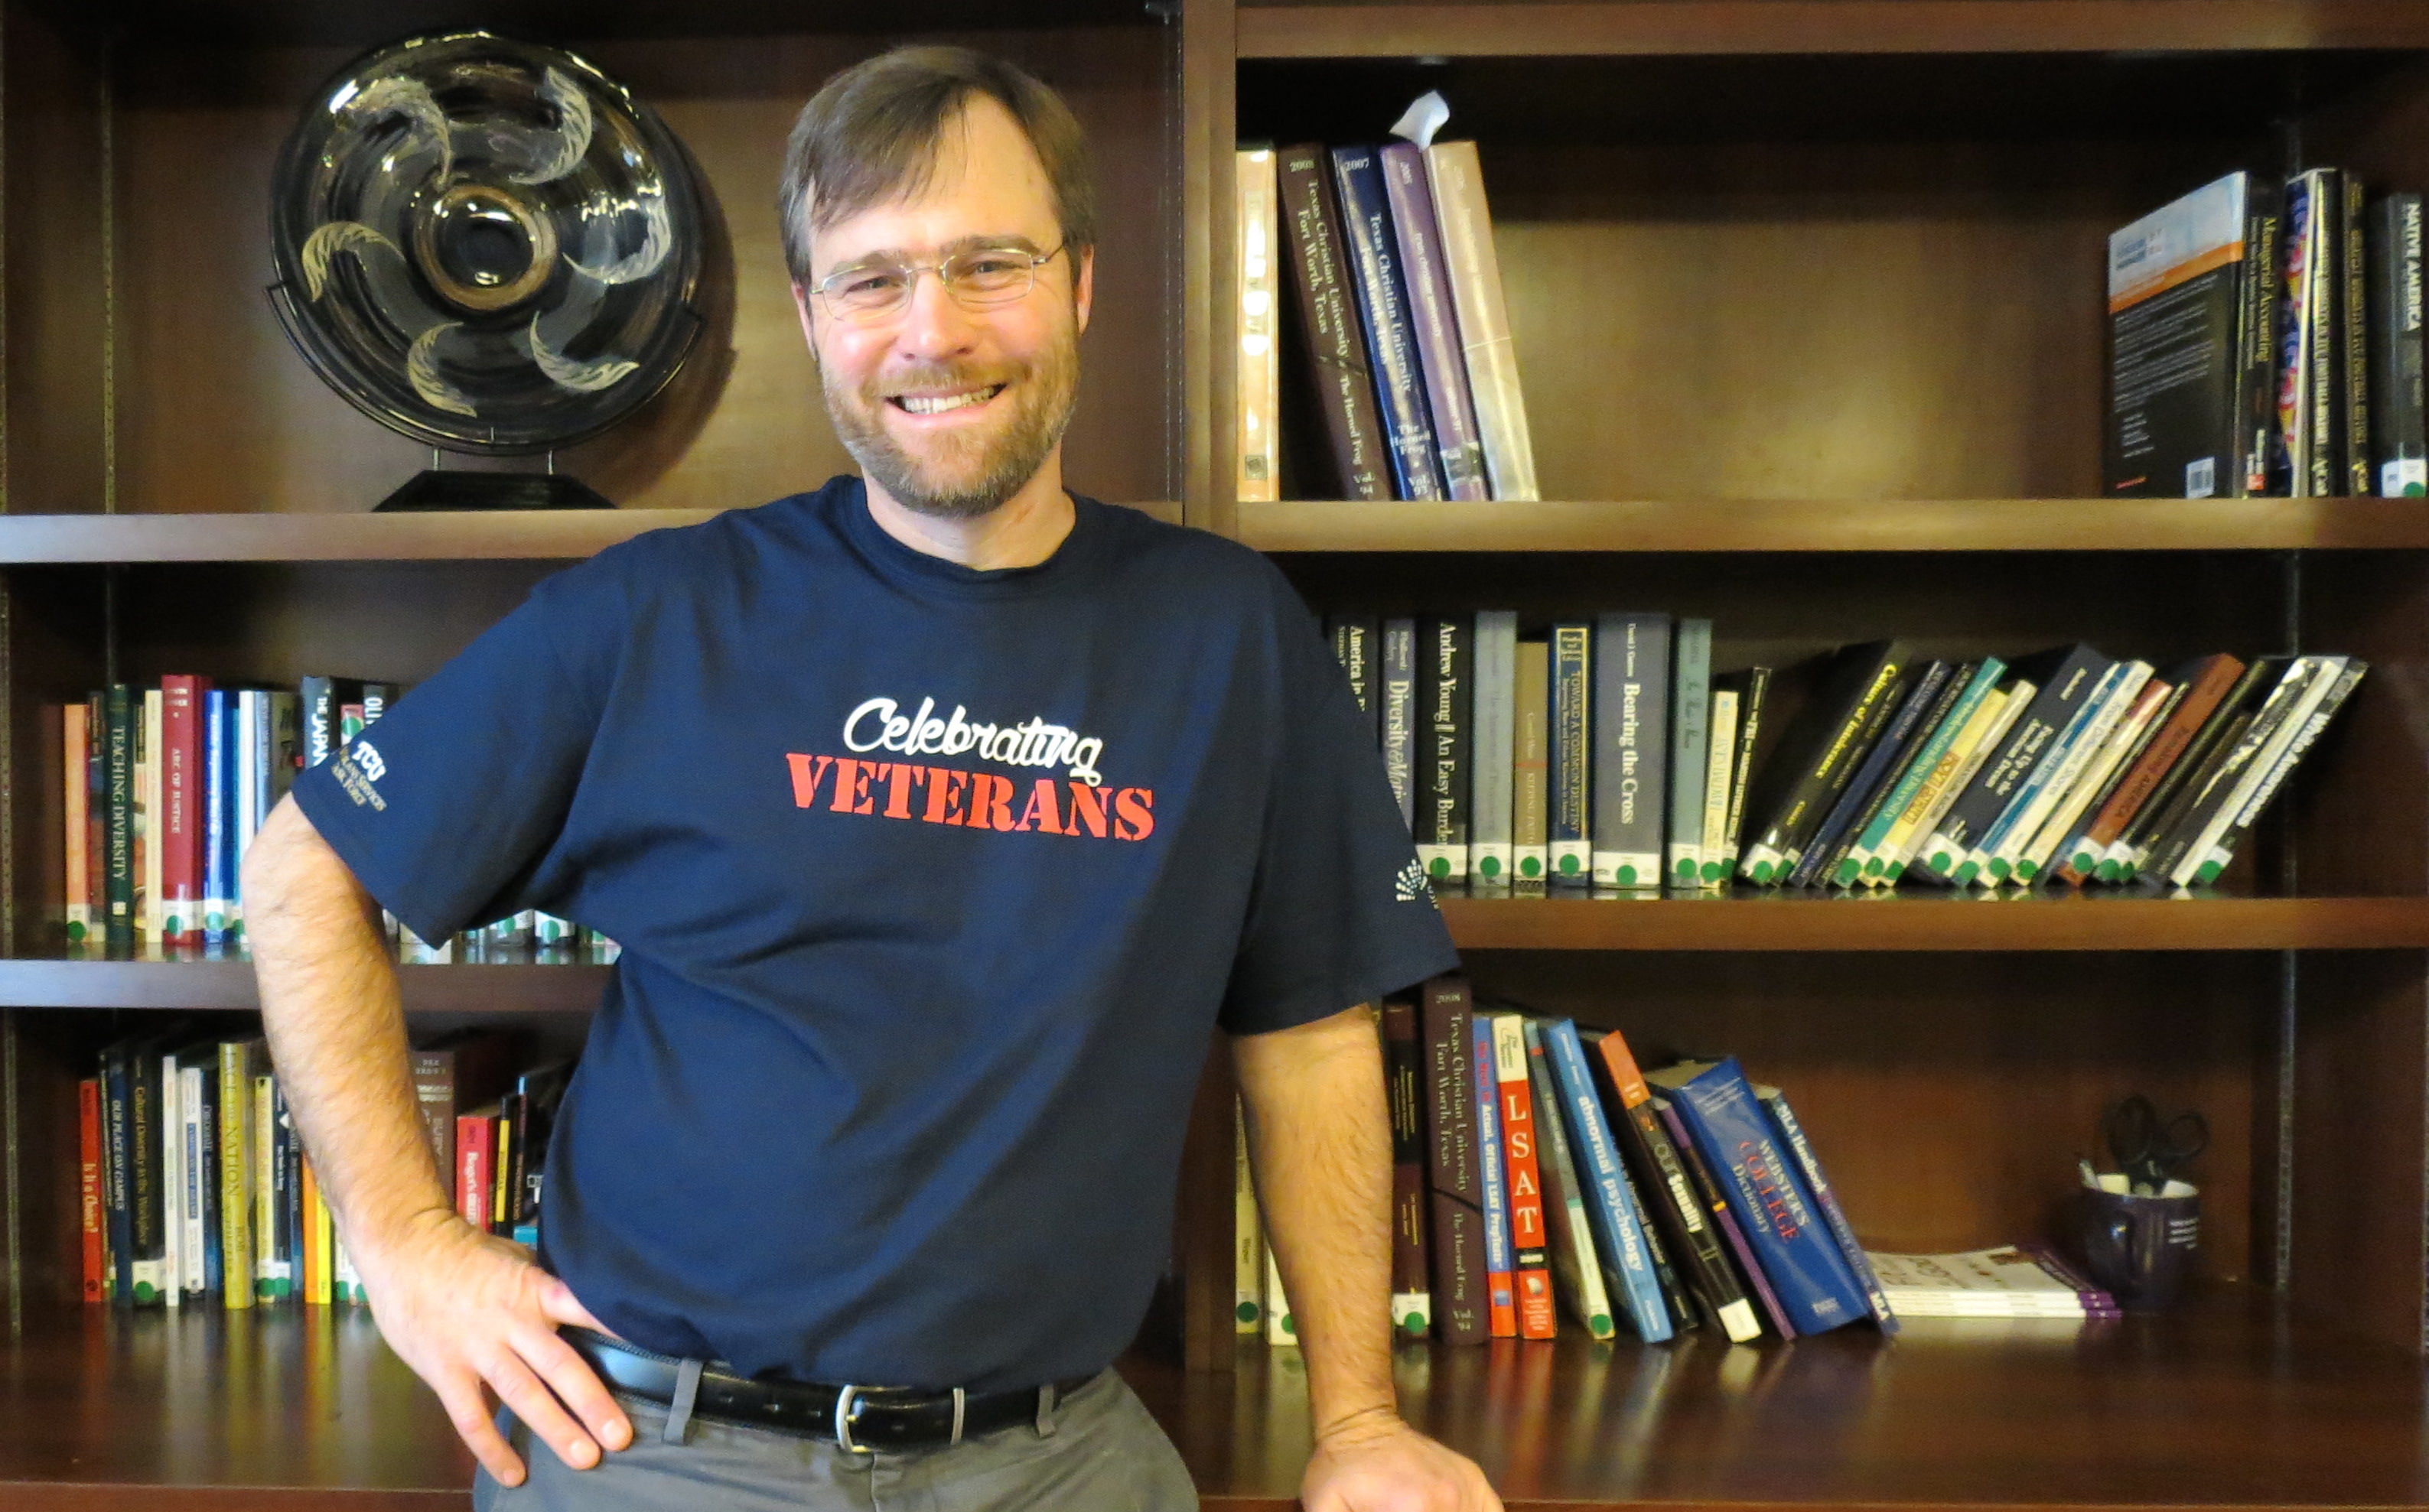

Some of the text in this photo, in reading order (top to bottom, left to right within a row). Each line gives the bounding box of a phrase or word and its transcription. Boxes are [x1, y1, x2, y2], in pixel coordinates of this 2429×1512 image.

[1298, 210, 1328, 333] Fort Worth, Texas
[1308, 179, 1351, 358] Texas Christian University
[1360, 246, 1373, 276] Fort
[1376, 327, 1389, 365] Texas
[1370, 212, 1411, 391] Texas Christian University
[2405, 203, 2423, 332] NATIVE AMERICA
[1340, 376, 1363, 465] The Horned Frog
[1393, 430, 1431, 445] Horned
[1398, 424, 1419, 434] The
[1350, 626, 1366, 679] America
[317, 697, 328, 714] THE
[843, 697, 1103, 788] Celebrating
[1385, 680, 1410, 750] Diversity
[1432, 623, 1458, 845] Andrew Young An Easy Burde
[1815, 664, 1897, 779] Culture of Intolerance
[171, 749, 182, 834] ARC OF JUSTICE
[352, 740, 386, 782] TCU
[1571, 670, 1582, 832] TOWARD A COMMON DESTINY
[1618, 683, 1642, 824] Bearing the Cross
[112, 726, 125, 880] TEACHING DIVERSITY
[785, 752, 1154, 841] VETERANS
[1435, 1040, 1452, 1167] Fort Worth, Texas
[1450, 1013, 1470, 1192] Texas Christian University
[1481, 1104, 1494, 1142] Actual,
[225, 1127, 242, 1197] NATION
[1483, 1143, 1499, 1182] Official
[1507, 1095, 1538, 1234] LSAT
[1578, 1095, 1643, 1273] abnormal psychology
[1738, 1140, 1798, 1243] COLLEGE
[1760, 1138, 1810, 1227] WEBSTER'S
[1776, 1103, 1828, 1193] MLA Handbook
[1486, 1184, 1500, 1210] LSAT
[1668, 1173, 1703, 1234] Sexuality
[1731, 1162, 1770, 1234] Dictionary
[1869, 1290, 1891, 1322] MLA
